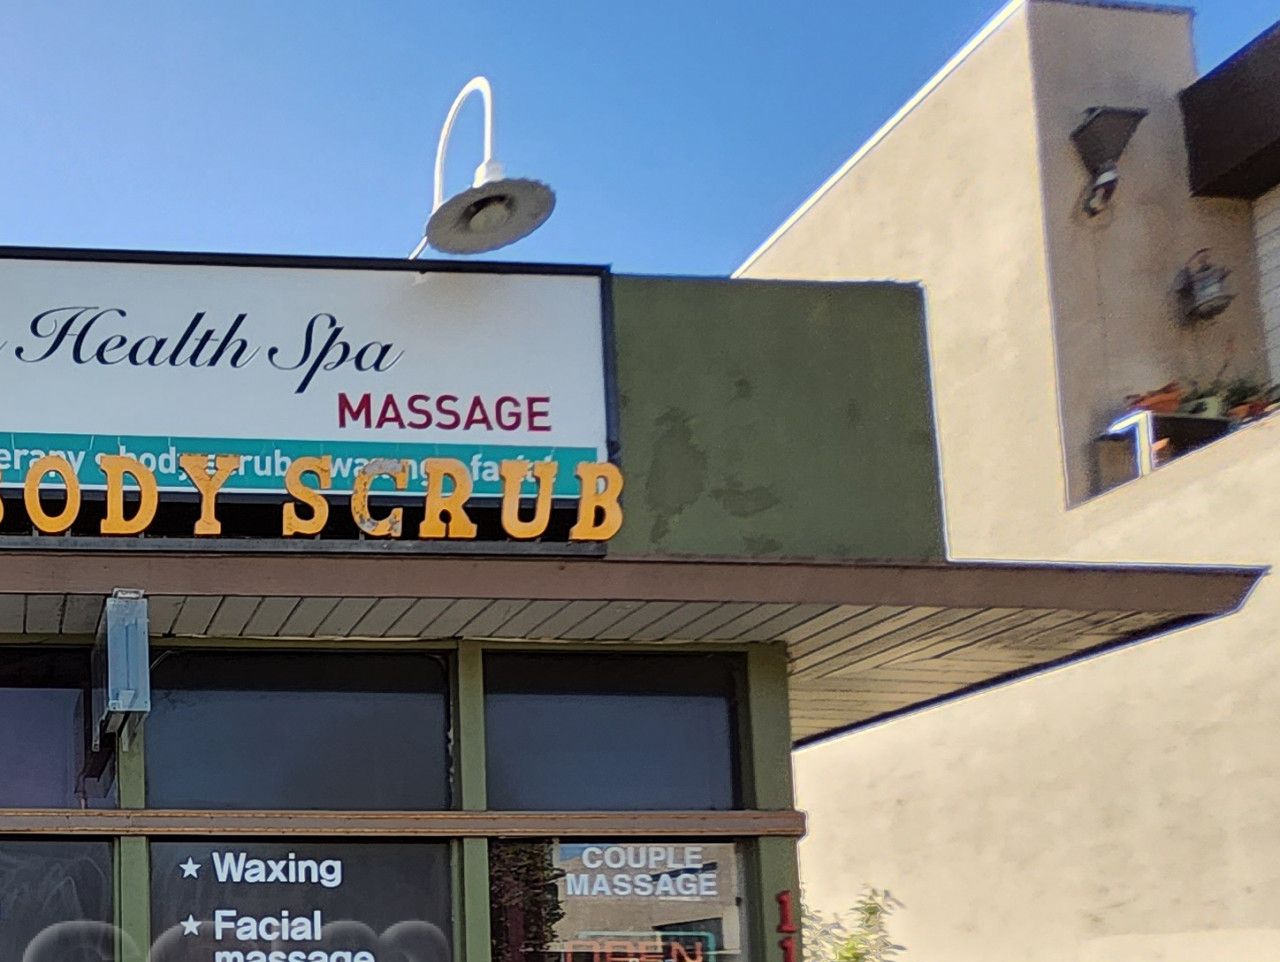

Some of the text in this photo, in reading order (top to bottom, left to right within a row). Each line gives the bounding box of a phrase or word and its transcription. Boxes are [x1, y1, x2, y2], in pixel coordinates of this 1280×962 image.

[15, 306, 261, 369] Health
[267, 312, 404, 394] Spa
[337, 392, 552, 433] MASSAGE
[283, 454, 624, 541] SCRUB
[212, 852, 342, 887] Waxing
[582, 846, 703, 868] COUPLE
[566, 873, 718, 896] MASSAGE
[214, 910, 322, 940] Facial
